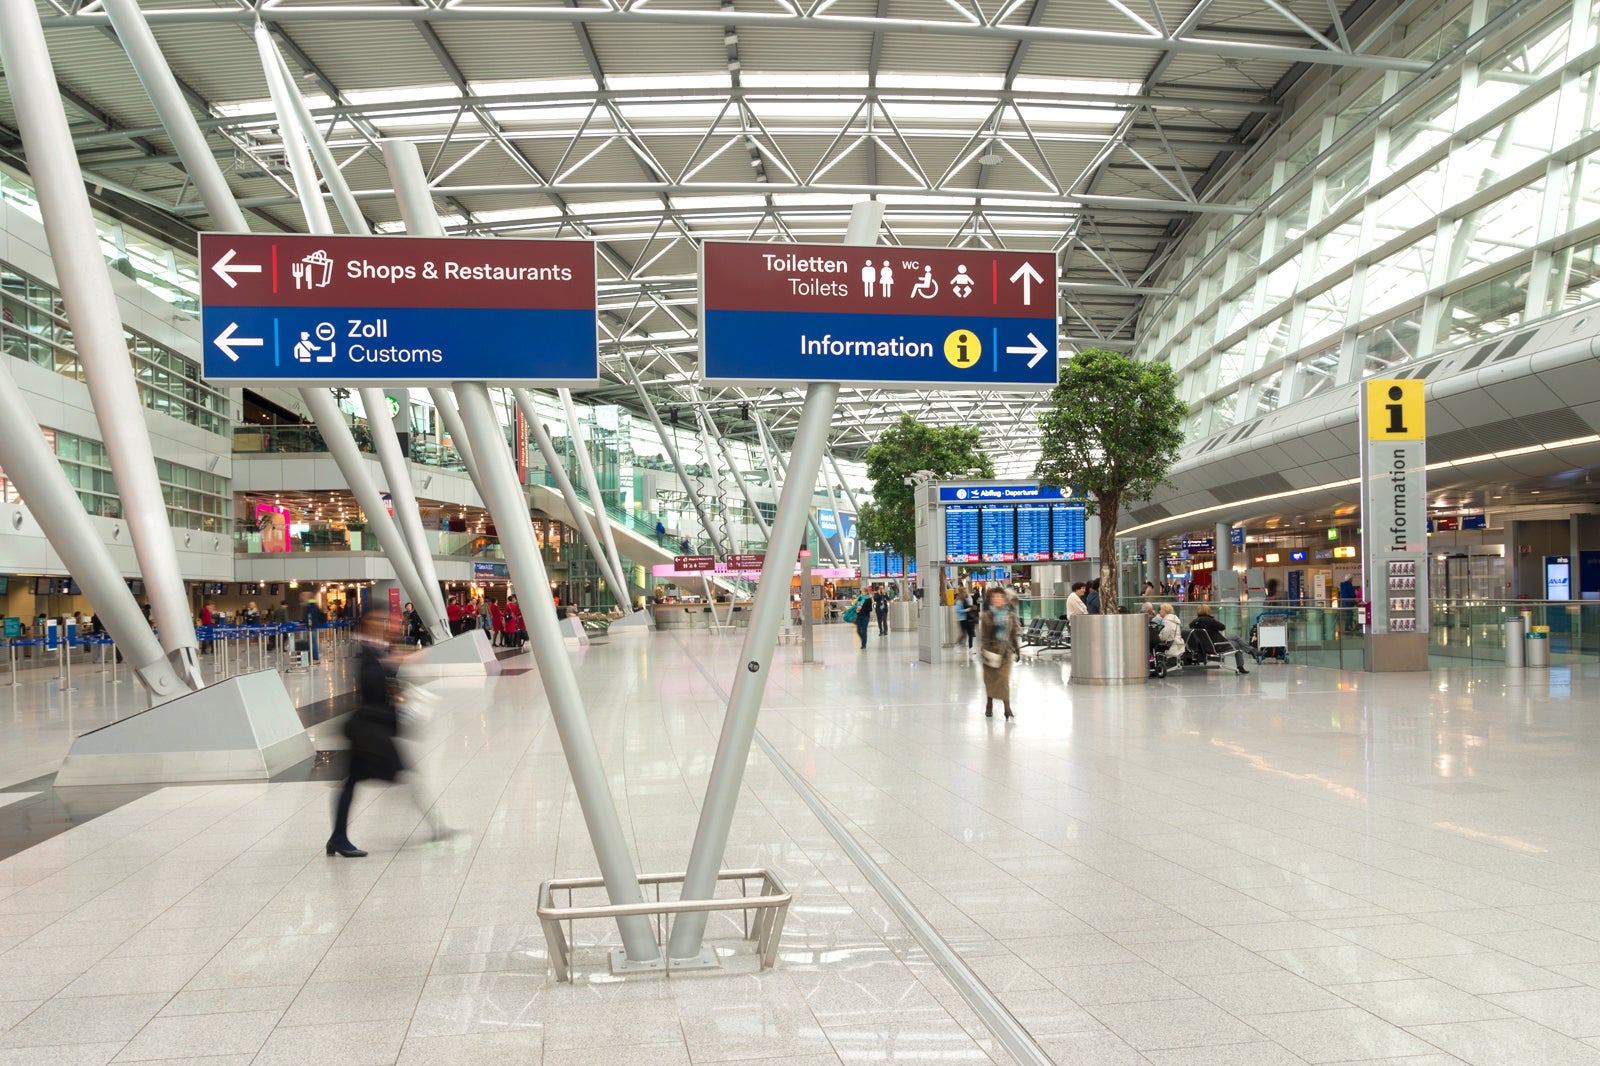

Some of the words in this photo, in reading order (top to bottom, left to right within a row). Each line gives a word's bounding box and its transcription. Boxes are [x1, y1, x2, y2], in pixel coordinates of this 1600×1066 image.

[346, 259, 417, 284] Shops
[421, 261, 439, 280] &
[444, 261, 573, 281] Restaurants
[762, 253, 848, 274] Toiletten
[901, 260, 920, 270] WC
[787, 277, 849, 297] Toilets
[347, 318, 388, 338] Zoll
[348, 344, 443, 363] Customs
[801, 334, 934, 358] Information
[980, 489, 1002, 498] Abflug
[1005, 489, 1039, 498] Departures
[1390, 449, 1407, 552] Information
